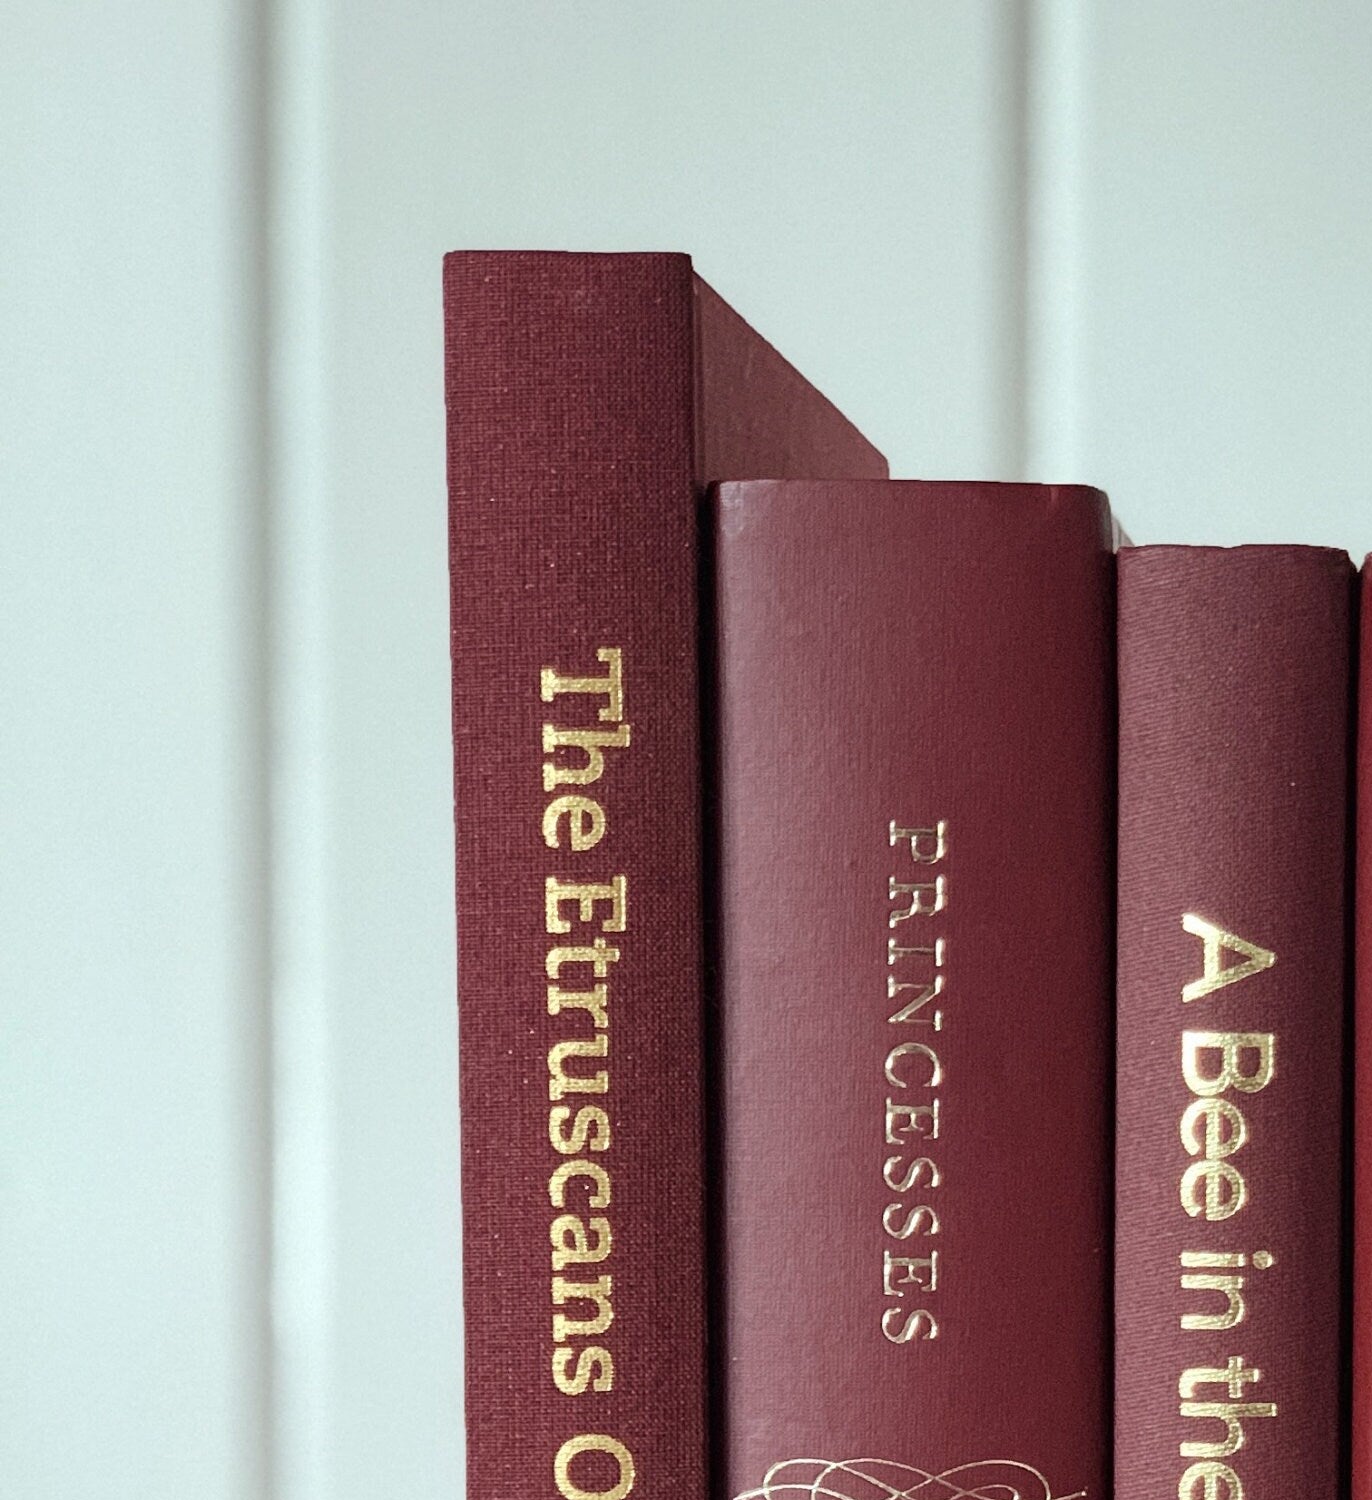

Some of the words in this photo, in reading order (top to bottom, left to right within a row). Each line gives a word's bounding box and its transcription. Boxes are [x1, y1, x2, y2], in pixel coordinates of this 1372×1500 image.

[541, 647, 630, 851] The
[1181, 912, 1275, 1002] A
[545, 874, 630, 1395] Etruscans
[880, 820, 948, 1344] PRINCESSES
[1180, 1030, 1275, 1221] Bee
[1179, 1251, 1274, 1331] in
